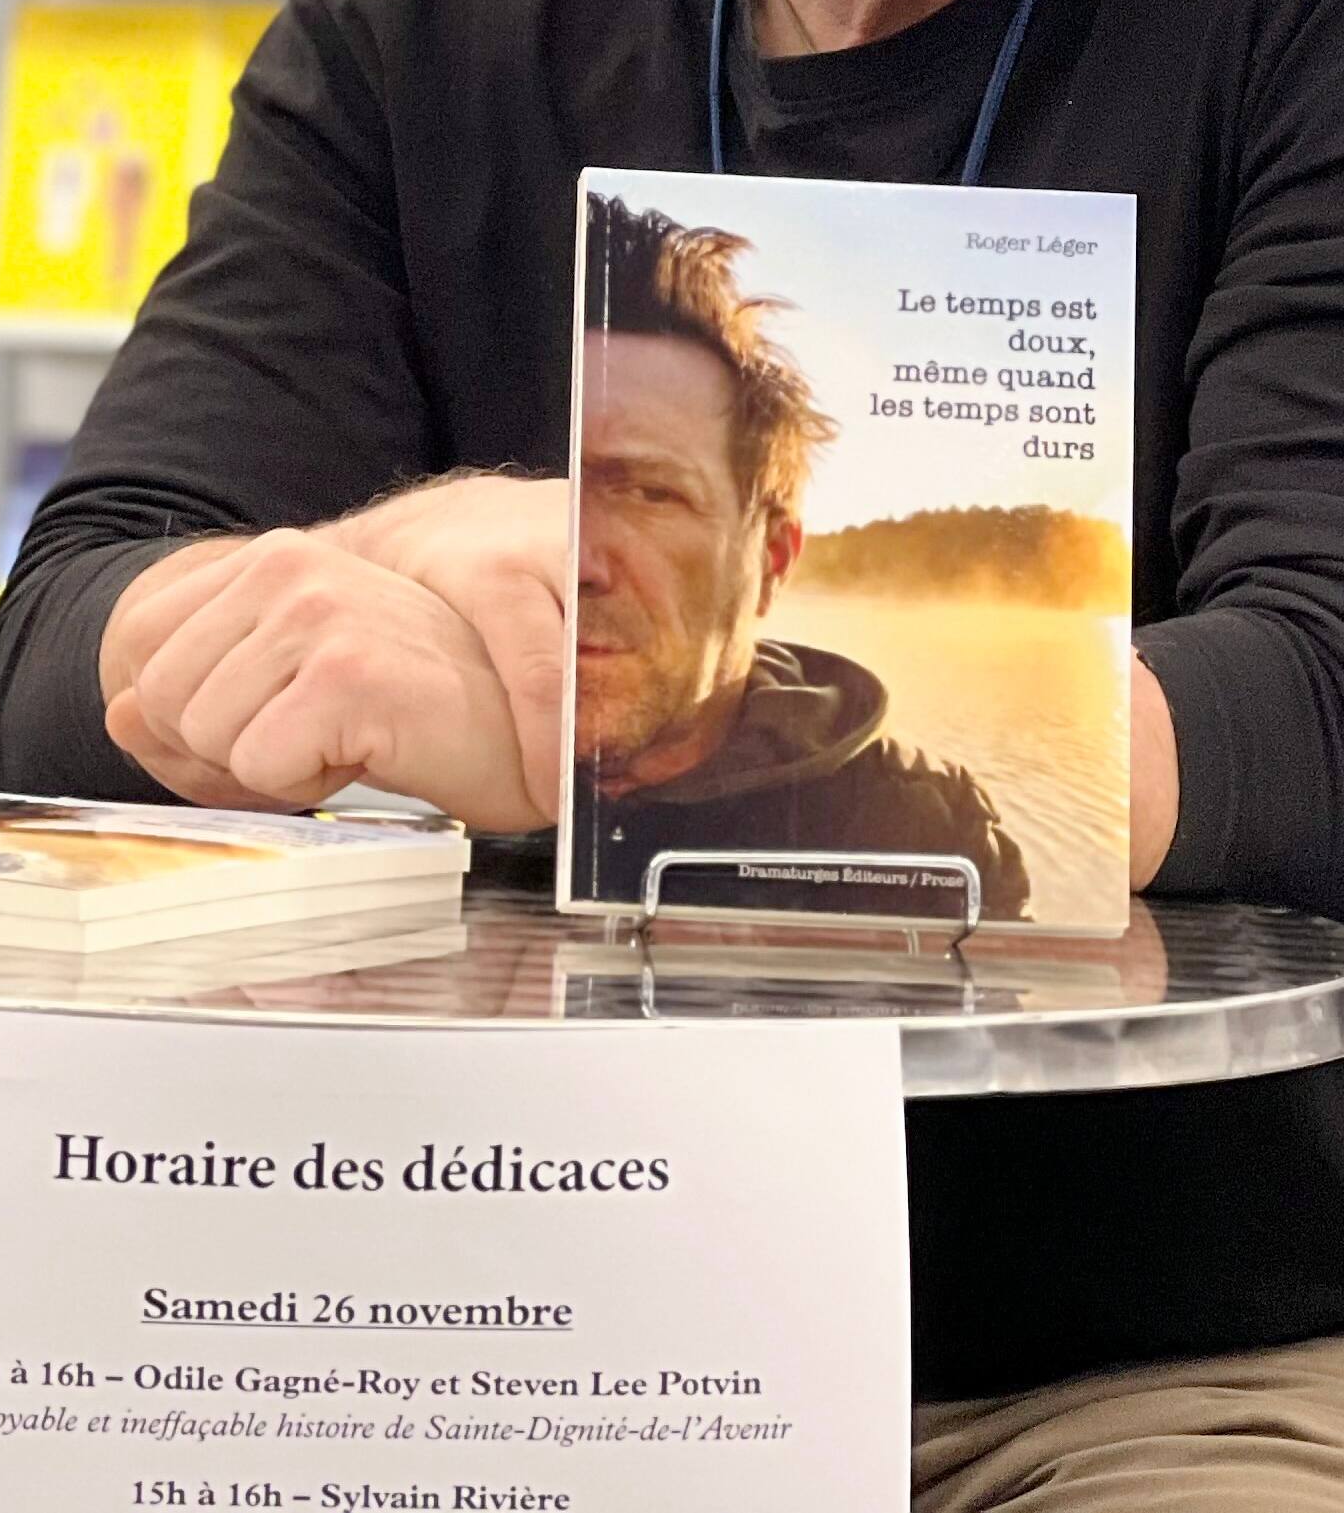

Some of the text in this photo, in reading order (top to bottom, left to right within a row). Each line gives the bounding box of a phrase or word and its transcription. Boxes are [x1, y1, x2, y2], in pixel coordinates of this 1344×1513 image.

[965, 232, 1098, 257] Roger Léger
[898, 289, 1097, 321] Le temps est
[1008, 329, 1096, 360] doux,
[893, 360, 1096, 391] même quand
[870, 393, 1096, 425] les temps sont
[1023, 435, 1094, 460] durs
[738, 864, 839, 883] Dramaturges
[843, 867, 908, 885] Éditeurs
[921, 872, 965, 887] Prose
[53, 1133, 670, 1192] Horaire des dédicaces
[143, 1287, 573, 1326] Samedi 26 novembre
[10, 1359, 28, 1385] à
[41, 1361, 95, 1387] 16h
[134, 1361, 223, 1391] Odile
[235, 1366, 420, 1400] Gagné-Roy
[430, 1373, 459, 1396] et
[471, 1370, 579, 1397] Steven
[591, 1372, 648, 1397] Lee
[659, 1371, 762, 1396] Potvin
[87, 1413, 110, 1433] et
[121, 1405, 266, 1442] ineffaçable
[276, 1411, 375, 1441] histoire
[385, 1413, 415, 1442] de
[424, 1413, 792, 1448] Sainte-Dignité-de-l’Avenir
[132, 1479, 185, 1506] 15h
[197, 1481, 216, 1506] à
[229, 1482, 282, 1507] 16h
[321, 1482, 440, 1513] Sylvain
[452, 1484, 571, 1512] Rivière
